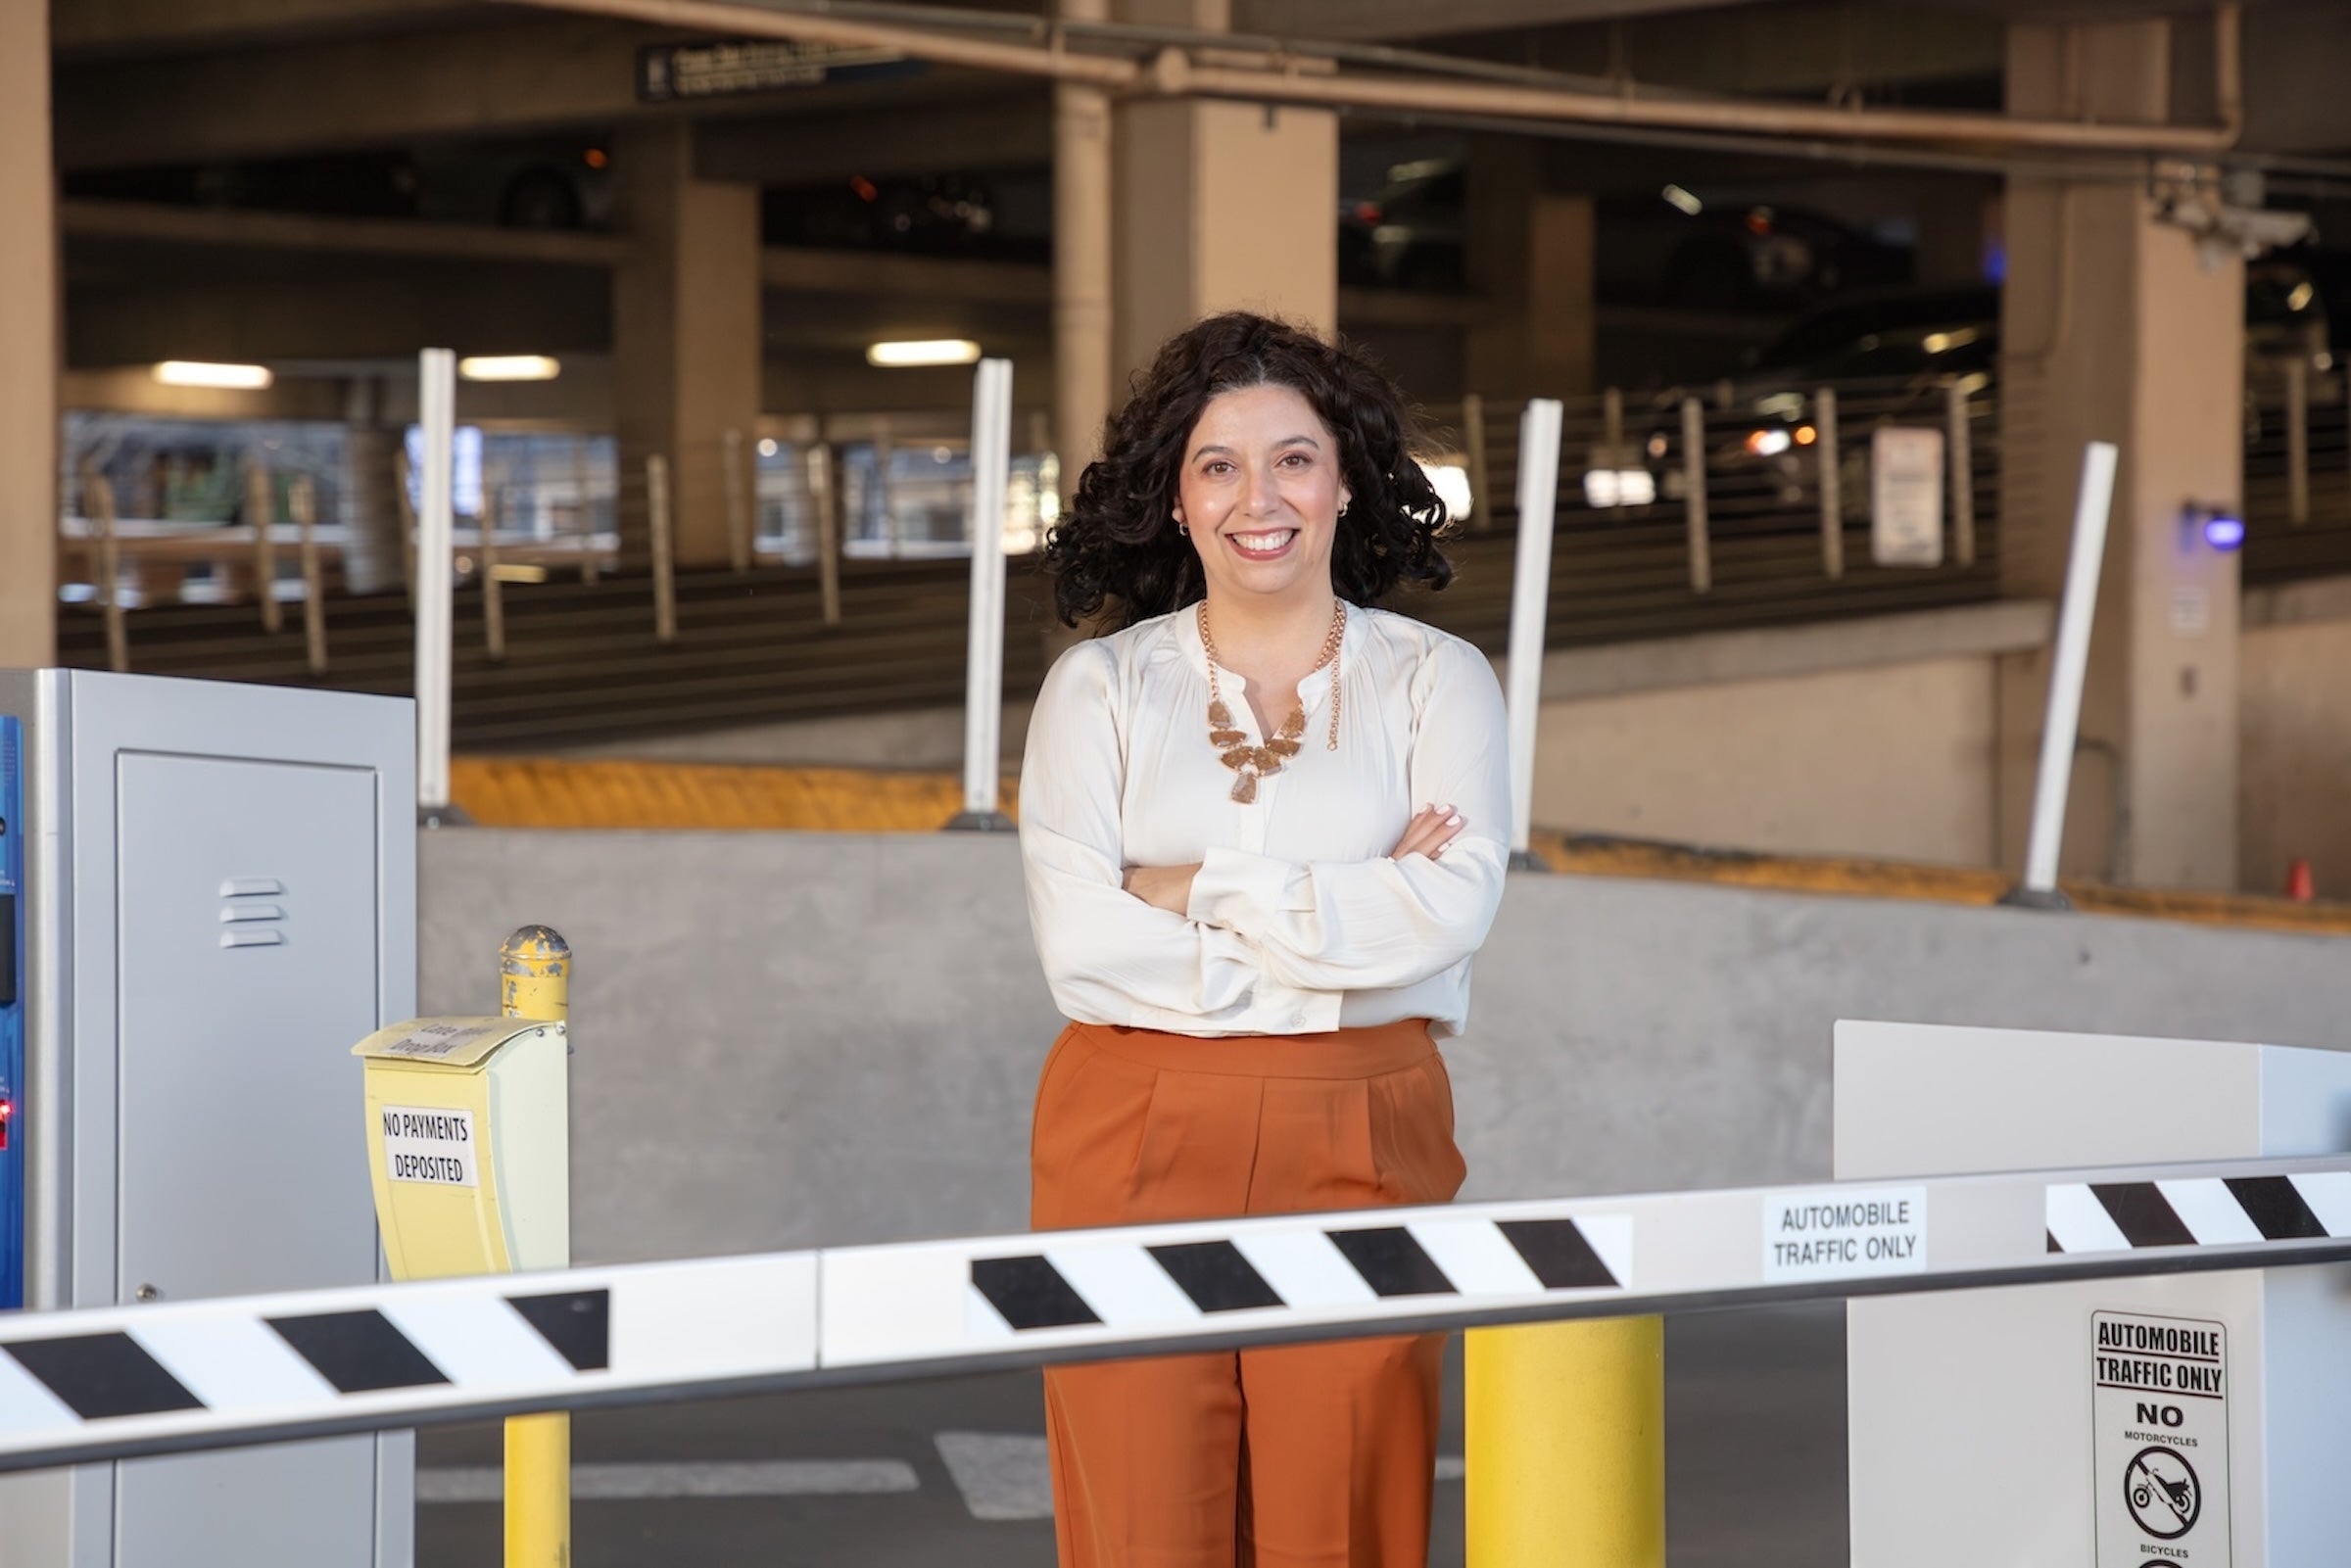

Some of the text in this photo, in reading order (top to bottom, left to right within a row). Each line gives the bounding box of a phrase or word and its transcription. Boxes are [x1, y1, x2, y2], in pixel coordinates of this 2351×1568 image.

[383, 1113, 468, 1142] NO PAYMENTS
[395, 1155, 463, 1182] DEPOSITED
[1781, 1201, 1910, 1232] AUTOMOBILE
[1774, 1235, 1917, 1267] TRAFFIC ONLY
[2098, 1322, 2220, 1356] AUTOMOBILE
[2096, 1357, 2223, 1393] TRAFFIC ONLY
[2135, 1402, 2184, 1427] NO
[2124, 1431, 2198, 1448] MOTORCYCLES
[2139, 1544, 2189, 1558] BICYCLES
